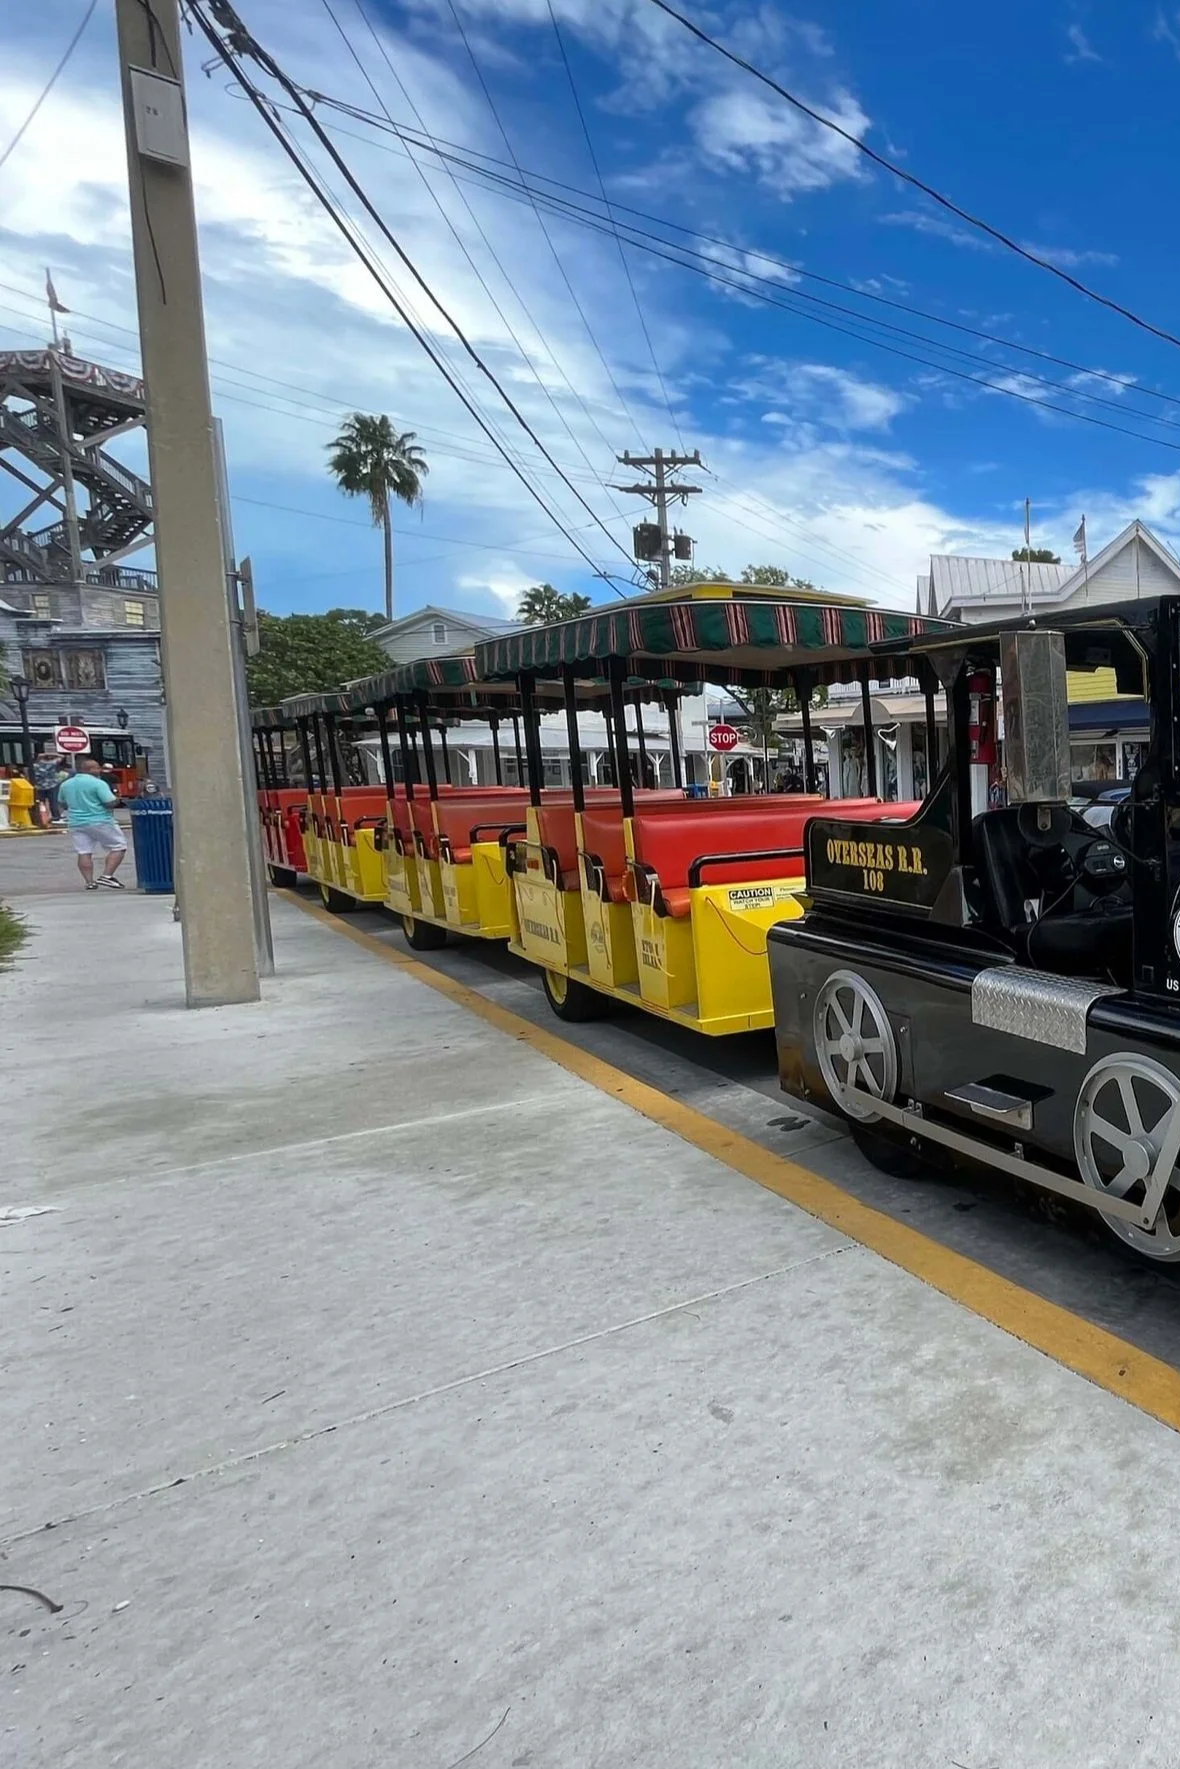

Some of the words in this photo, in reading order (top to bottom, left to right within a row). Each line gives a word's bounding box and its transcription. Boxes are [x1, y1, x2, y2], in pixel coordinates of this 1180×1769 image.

[710, 733, 736, 744] STOP
[826, 838, 894, 871] OVERSEAS
[897, 845, 928, 876] R.R.
[863, 868, 884, 892] 108
[729, 888, 771, 899] CAUTION
[1166, 978, 1179, 991] US
